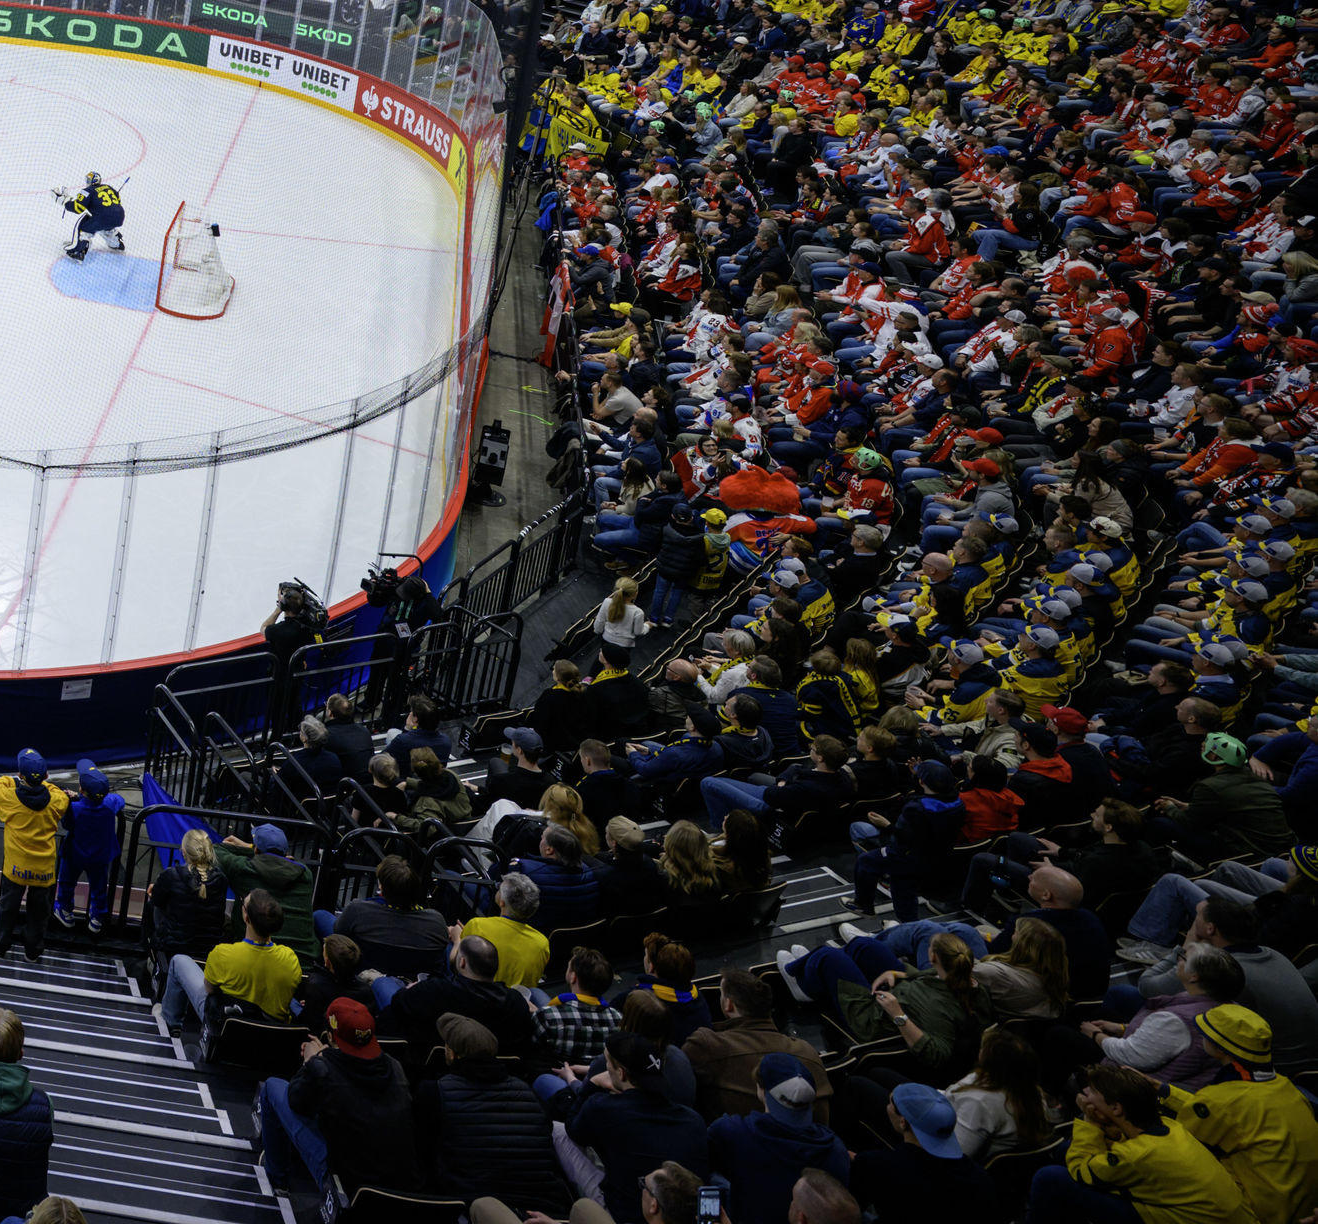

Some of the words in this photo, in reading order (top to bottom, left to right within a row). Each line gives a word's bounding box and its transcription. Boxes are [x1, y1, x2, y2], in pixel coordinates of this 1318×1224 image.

[219, 42, 283, 71] UNIBET
[292, 60, 350, 91] UNIBET
[380, 96, 450, 159] STRAUSS
[98, 188, 122, 209] 33
